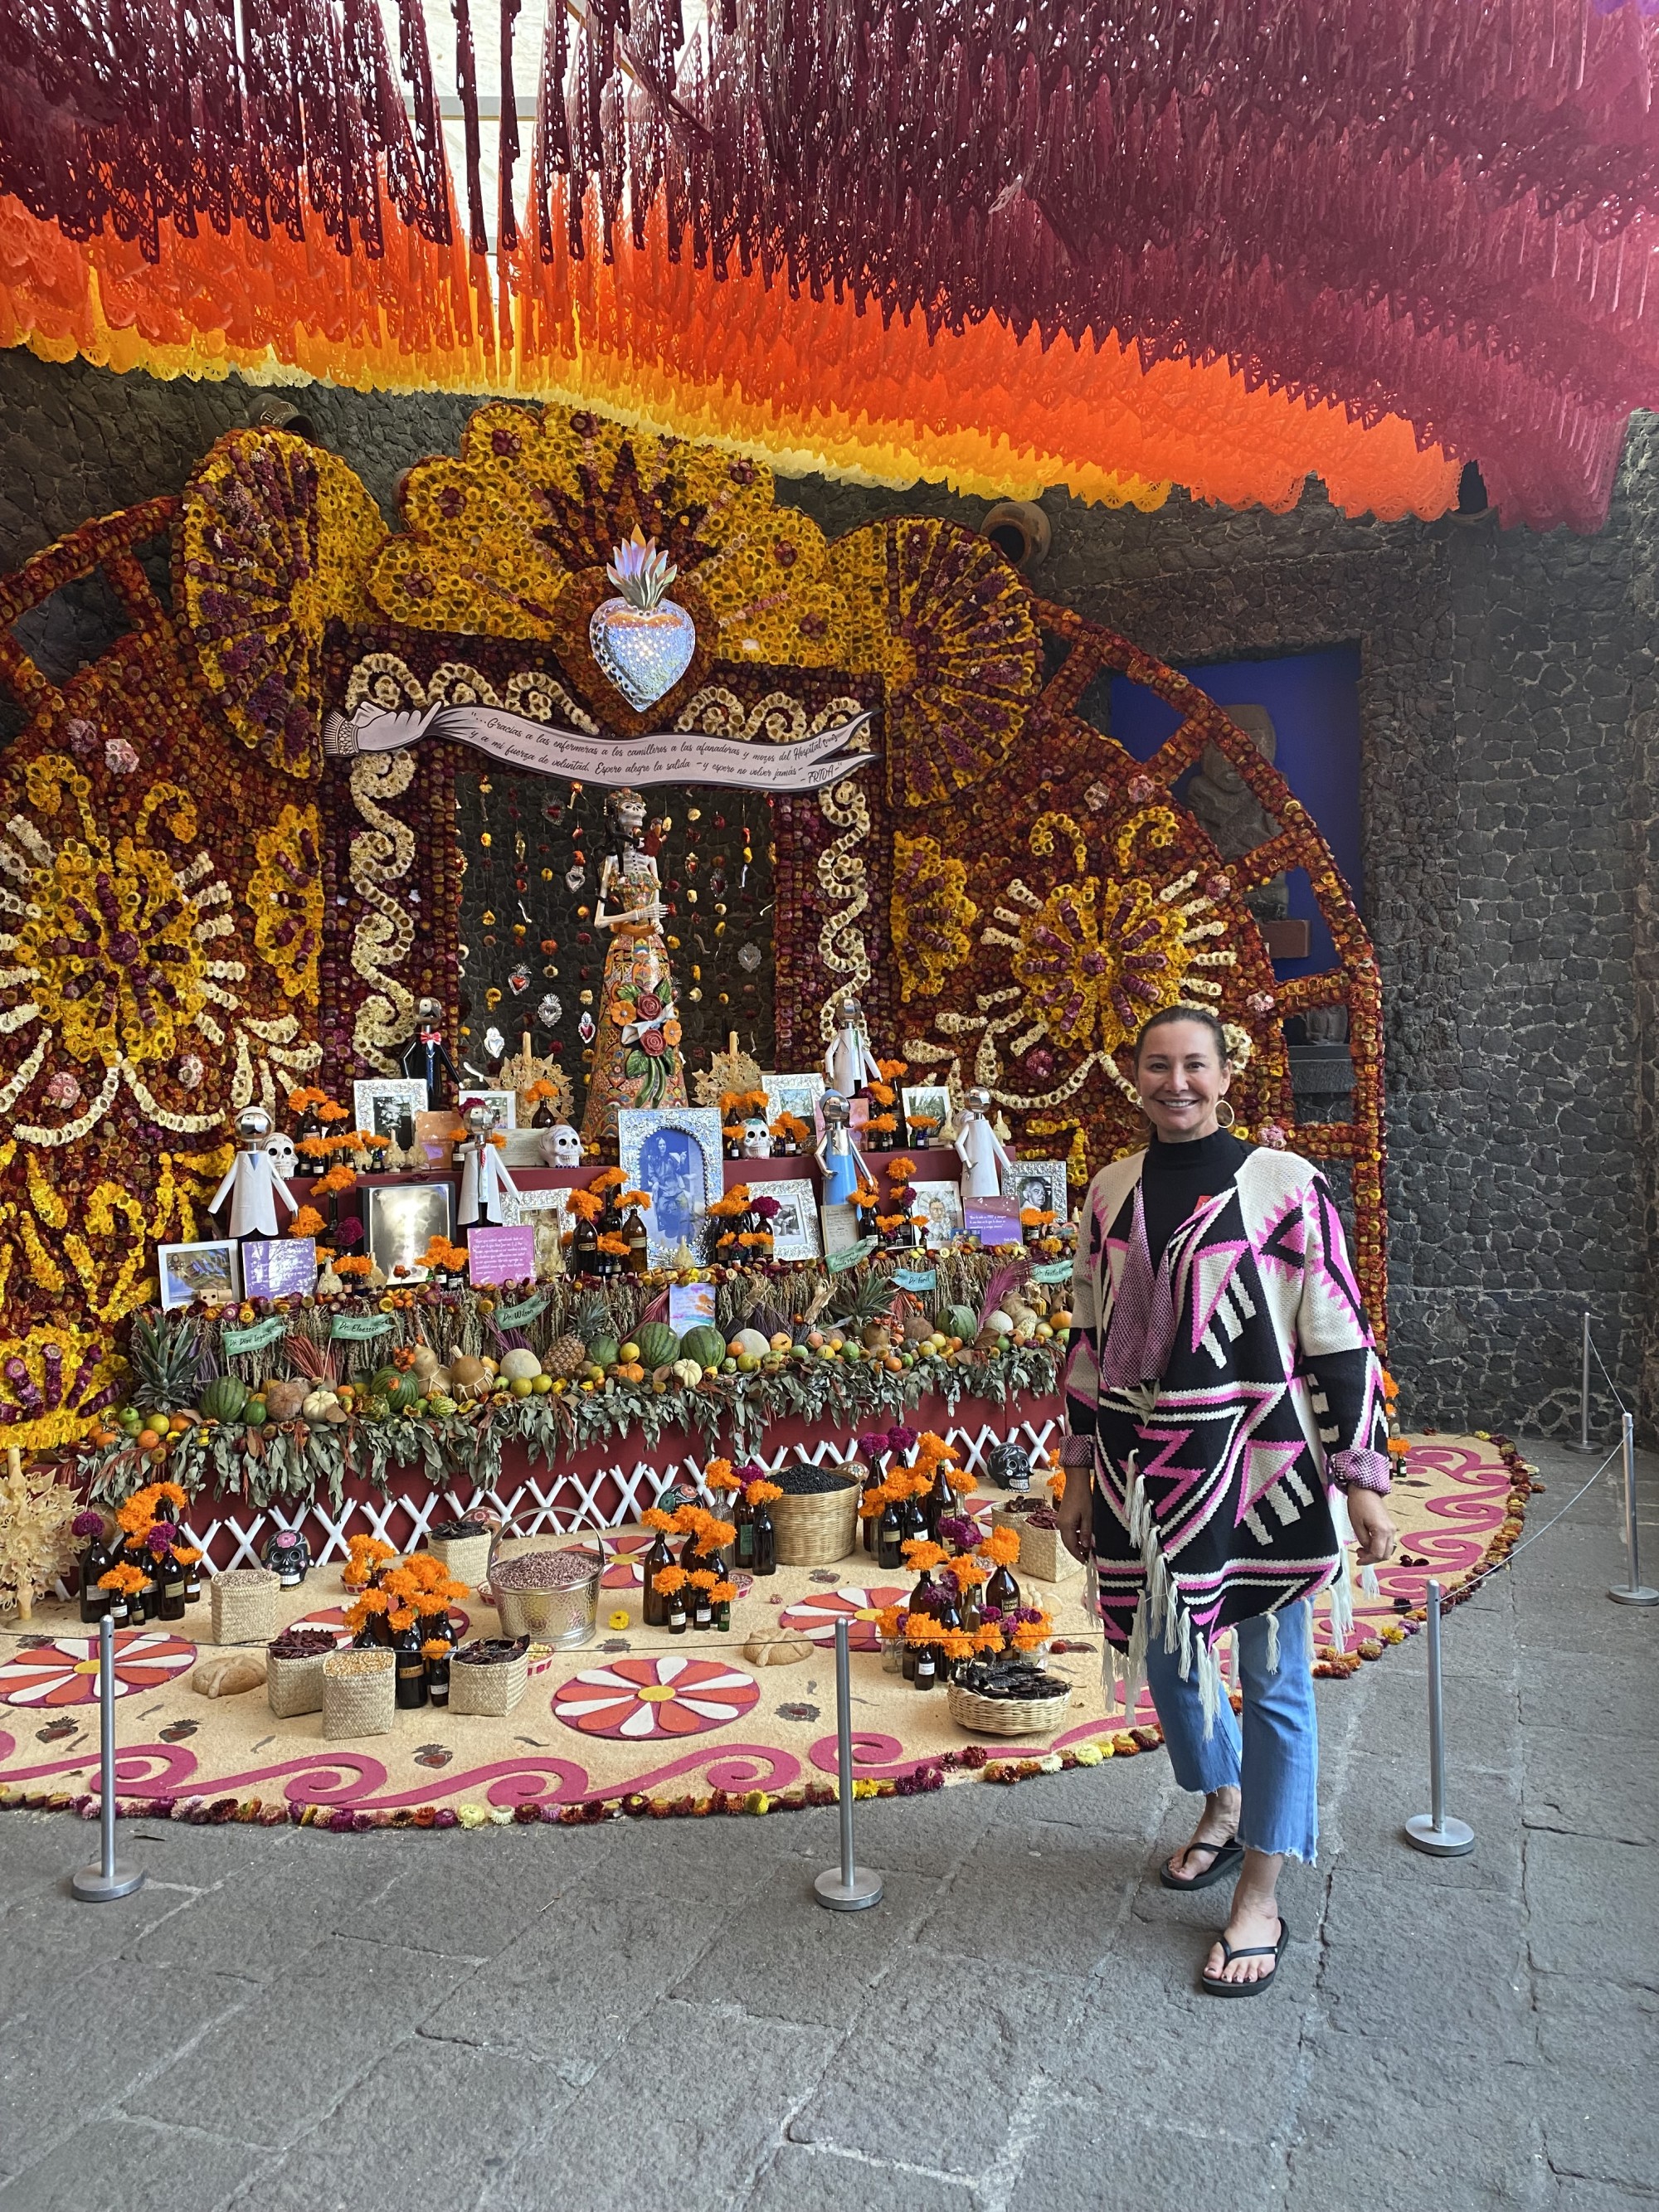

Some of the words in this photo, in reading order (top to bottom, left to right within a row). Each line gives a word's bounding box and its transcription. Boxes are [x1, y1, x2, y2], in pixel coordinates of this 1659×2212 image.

[469, 730, 479, 739] y
[491, 741, 504, 750] mi
[504, 745, 536, 761] fuerza
[538, 754, 550, 764] de
[552, 758, 590, 771] voluntad.
[595, 761, 622, 776] Espero
[625, 762, 650, 776] alegre
[654, 761, 663, 771] la
[666, 758, 690, 771] salida
[713, 763, 735, 774] espero
[749, 766, 772, 777] volver
[536, 734, 551, 746] las
[553, 741, 598, 755] enfermeras
[612, 746, 624, 756] los
[627, 743, 668, 757] camilleros
[680, 741, 693, 752] las
[696, 742, 740, 756] afanadoras
[742, 751, 750, 760] y
[752, 754, 776, 764] mozos
[779, 751, 791, 761] del
[793, 737, 822, 761] Hospital
[514, 1309, 533, 1320] Wilson
[351, 1324, 379, 1333] Eloesser
